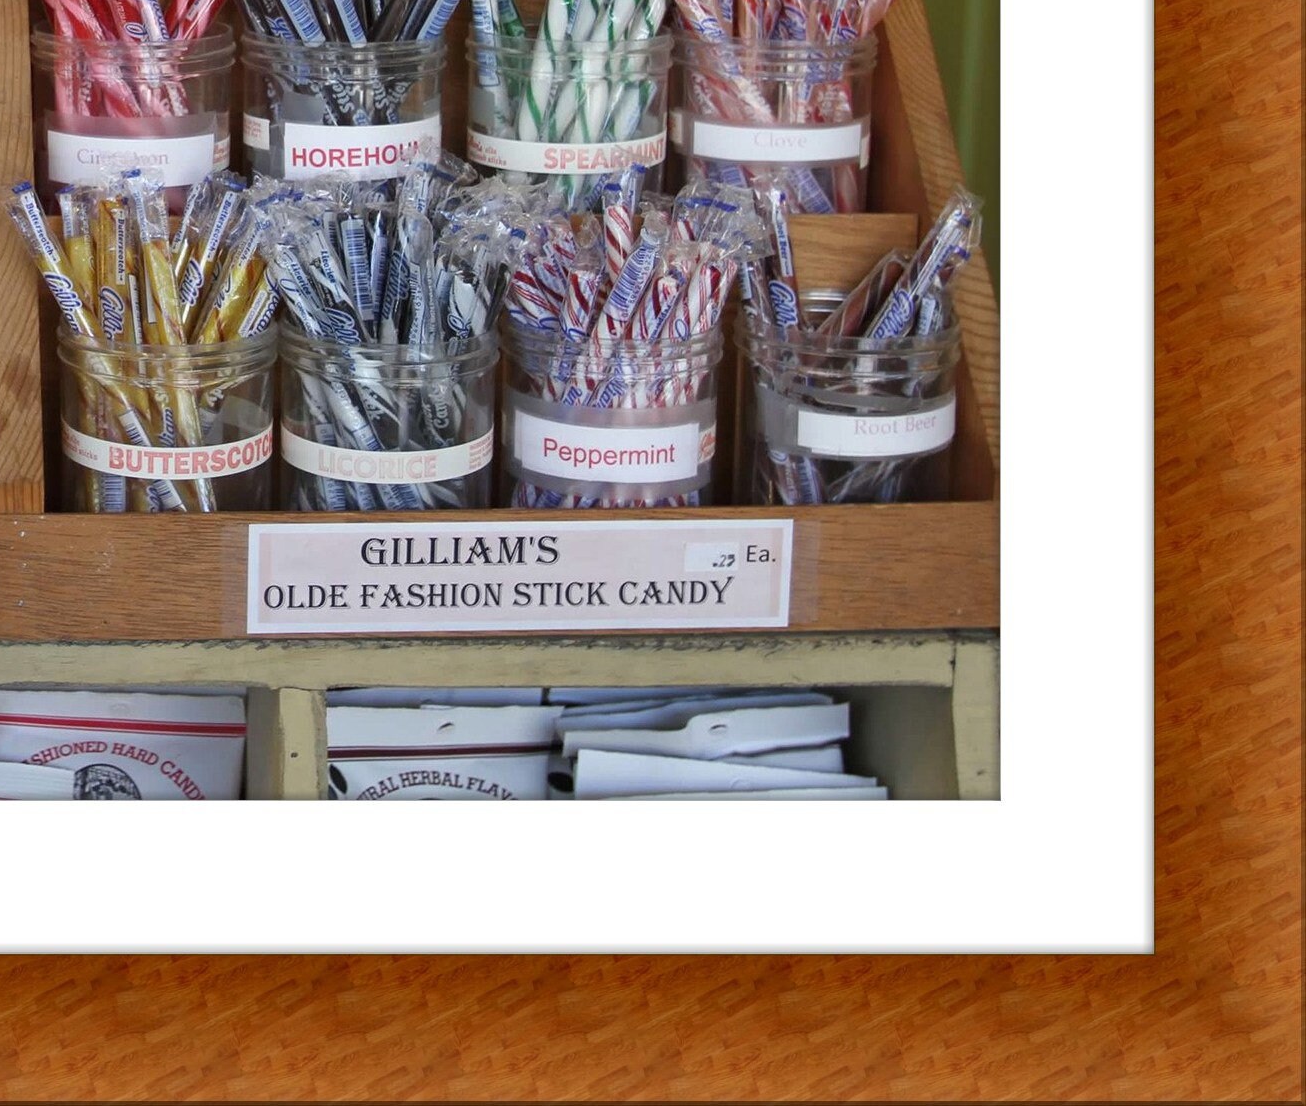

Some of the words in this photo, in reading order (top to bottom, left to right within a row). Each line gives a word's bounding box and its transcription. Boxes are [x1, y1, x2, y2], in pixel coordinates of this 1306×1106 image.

[543, 139, 666, 171] SPEARMINT
[753, 131, 807, 150] Clove
[25, 201, 54, 258] Butterscotch
[117, 217, 126, 276] Butterscotch
[854, 415, 901, 436] Root
[904, 413, 938, 435] Beer
[317, 449, 438, 479] LICORICE
[542, 437, 676, 469] Peppermint
[360, 535, 560, 567] GILLIAM'S
[745, 545, 777, 564] Ea.
[264, 584, 349, 611] OLDE
[360, 581, 503, 609] FASHION
[512, 580, 609, 607] STICK
[618, 576, 735, 606] CANDY
[23, 740, 108, 765] SHIONED
[111, 742, 160, 765] HARD
[399, 770, 463, 787] HERBAL
